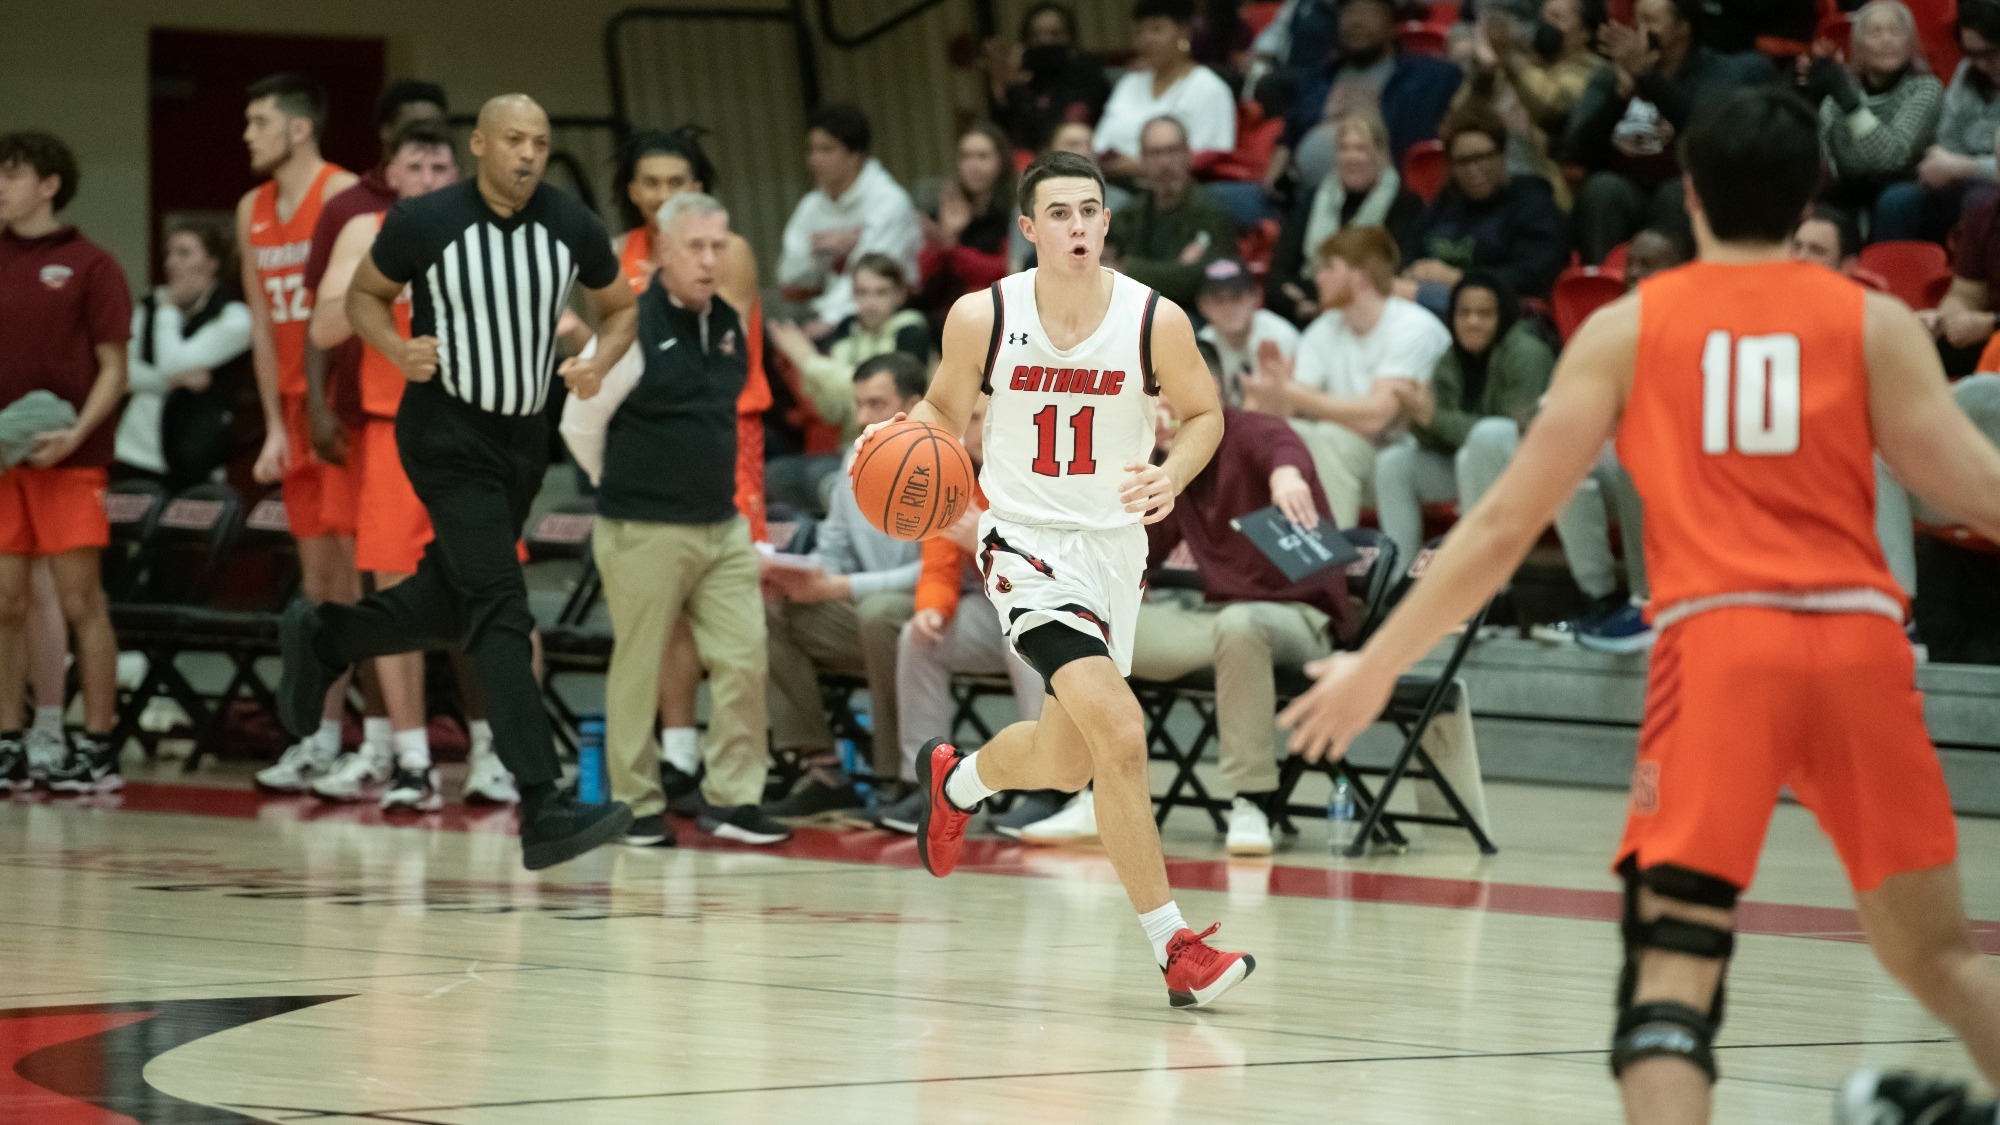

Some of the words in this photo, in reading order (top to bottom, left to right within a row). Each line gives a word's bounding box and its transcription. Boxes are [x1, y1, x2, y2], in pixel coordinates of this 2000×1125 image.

[265, 273, 312, 323] 32
[1009, 365, 1126, 396] CATHOLIC
[1700, 329, 1800, 455] 10
[1031, 404, 1097, 477] 11
[900, 465, 930, 509] ROCK
[895, 512, 921, 537] THE
